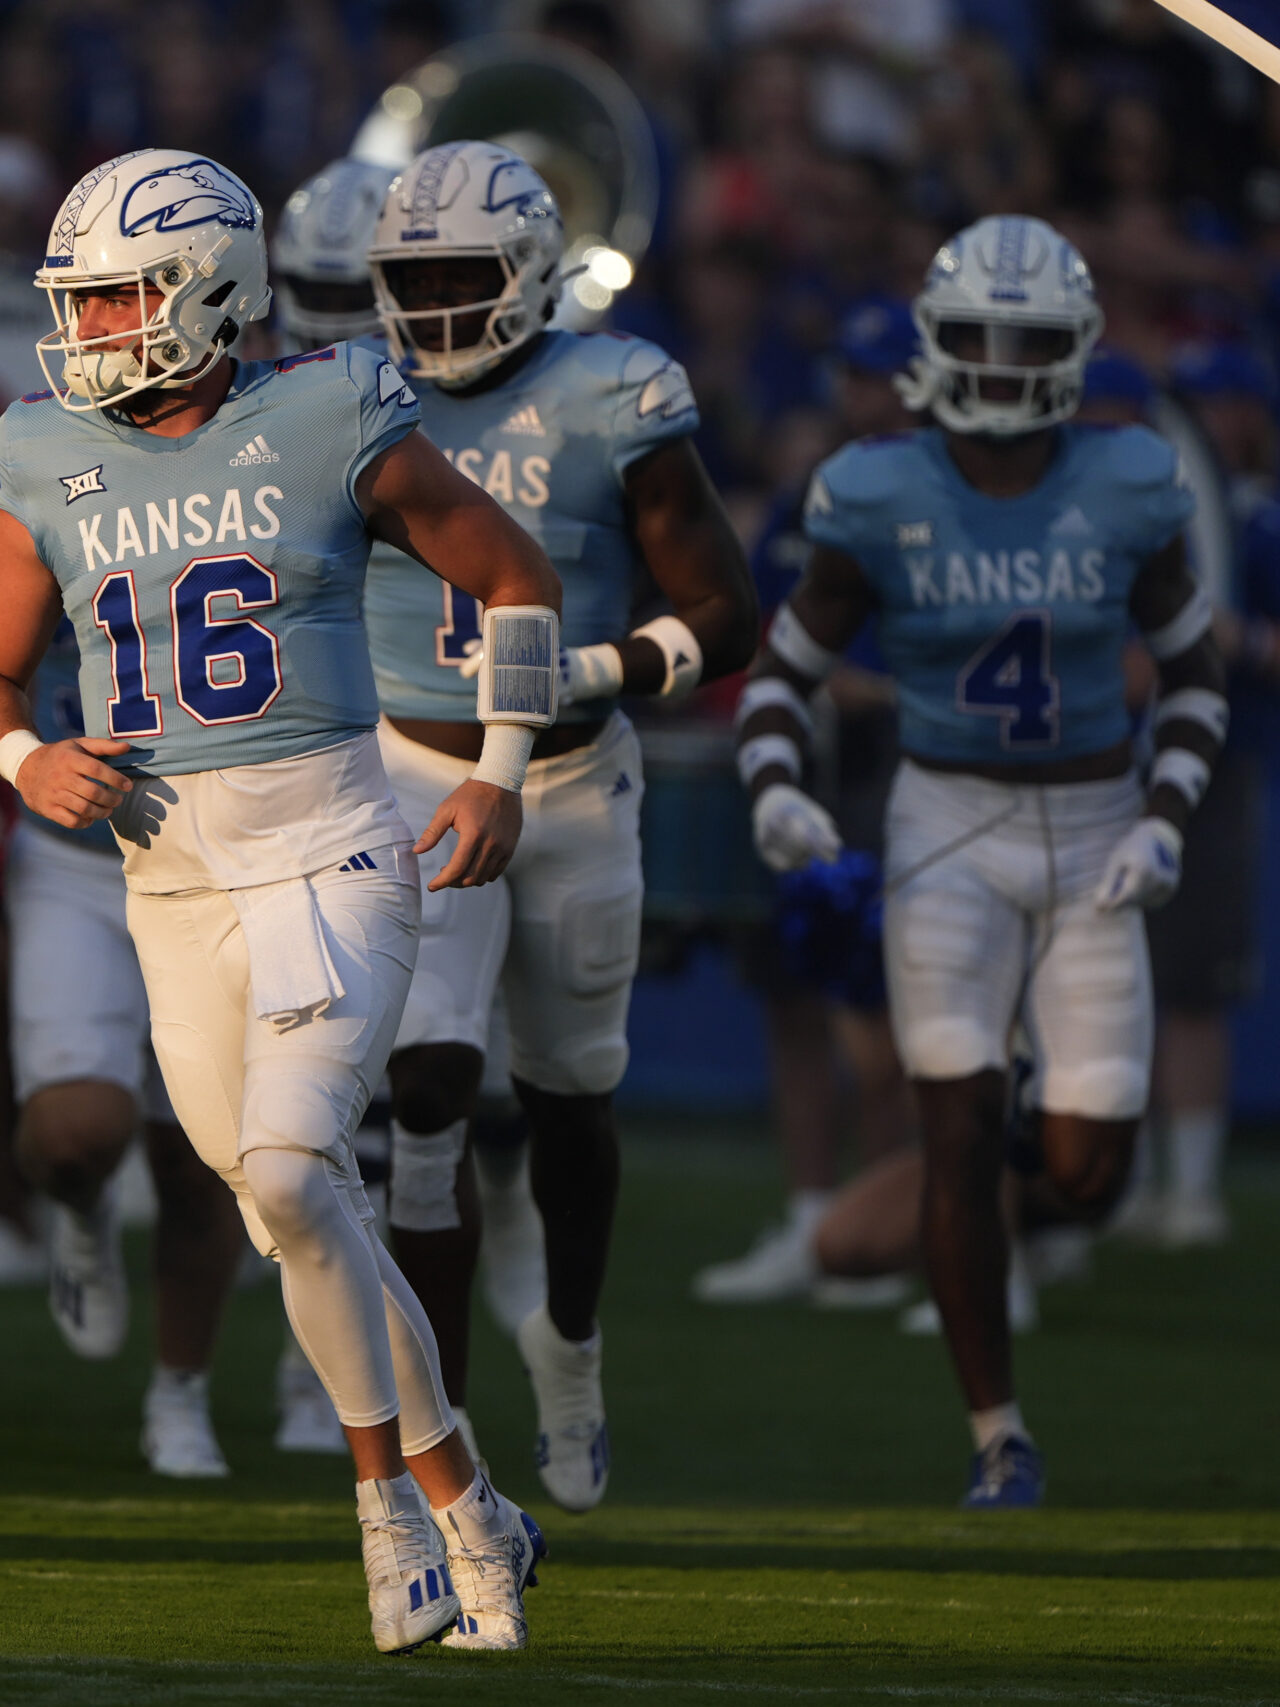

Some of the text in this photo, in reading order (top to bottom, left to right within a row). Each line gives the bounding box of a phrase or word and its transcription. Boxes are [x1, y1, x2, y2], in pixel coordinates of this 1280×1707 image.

[229, 451, 281, 467] adidas
[78, 485, 285, 572] KANSAS
[904, 547, 1107, 607] KANSAS
[91, 552, 283, 739] 16
[955, 607, 1061, 751] 4
